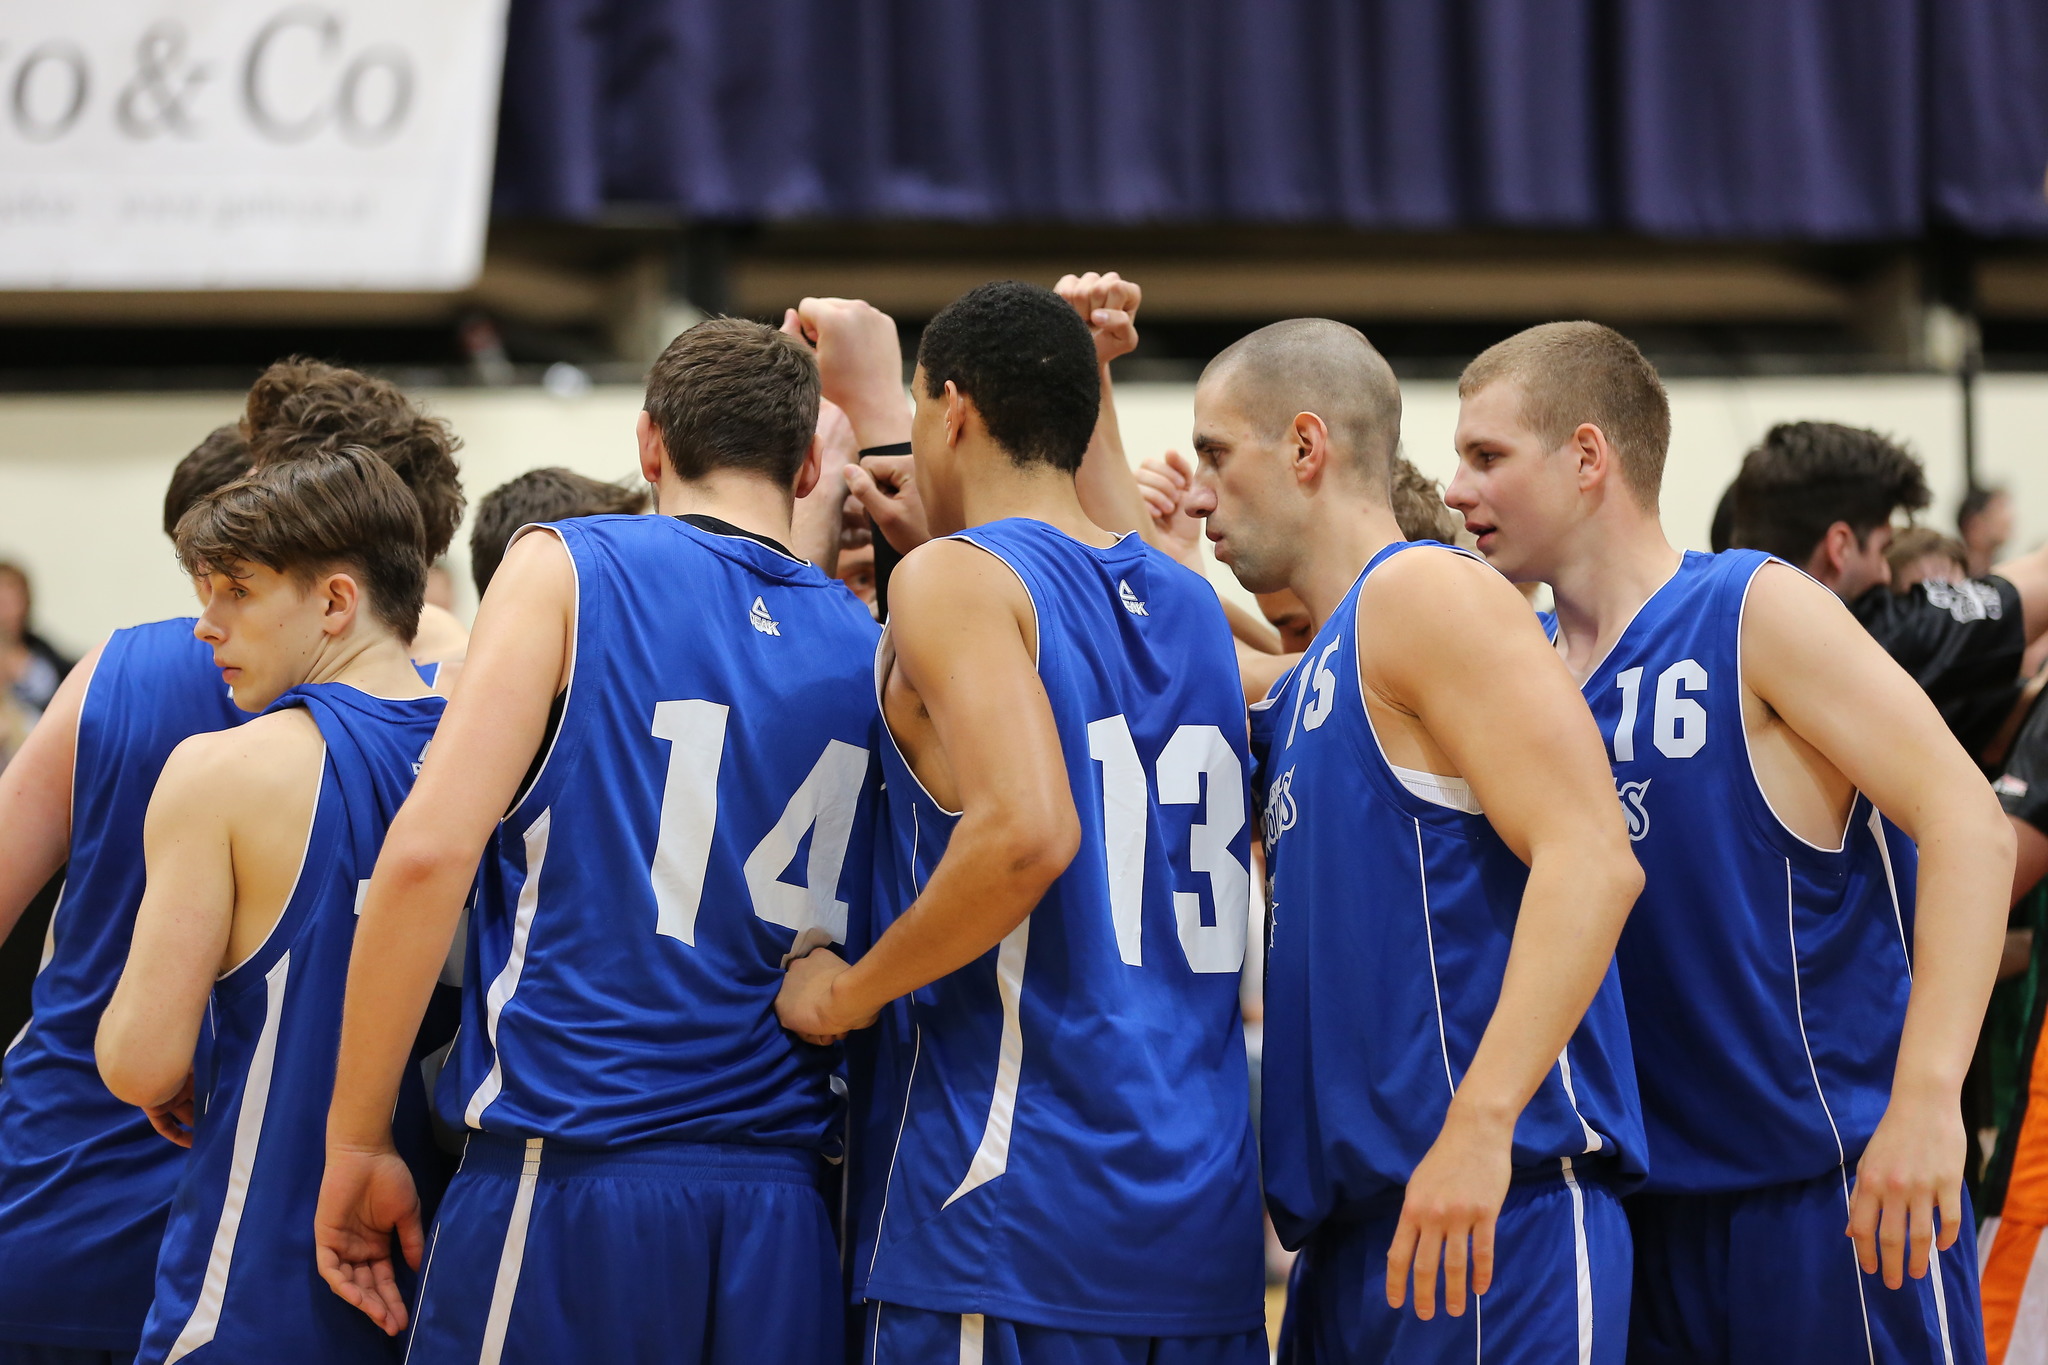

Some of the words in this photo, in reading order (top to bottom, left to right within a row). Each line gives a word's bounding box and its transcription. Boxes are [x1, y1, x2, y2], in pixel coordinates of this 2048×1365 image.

[112, 15, 214, 144] &
[239, 4, 420, 150] Co
[1285, 633, 1340, 751] 15
[1614, 658, 1708, 762] 16
[651, 699, 870, 955] 14
[1087, 713, 1251, 974] 13
